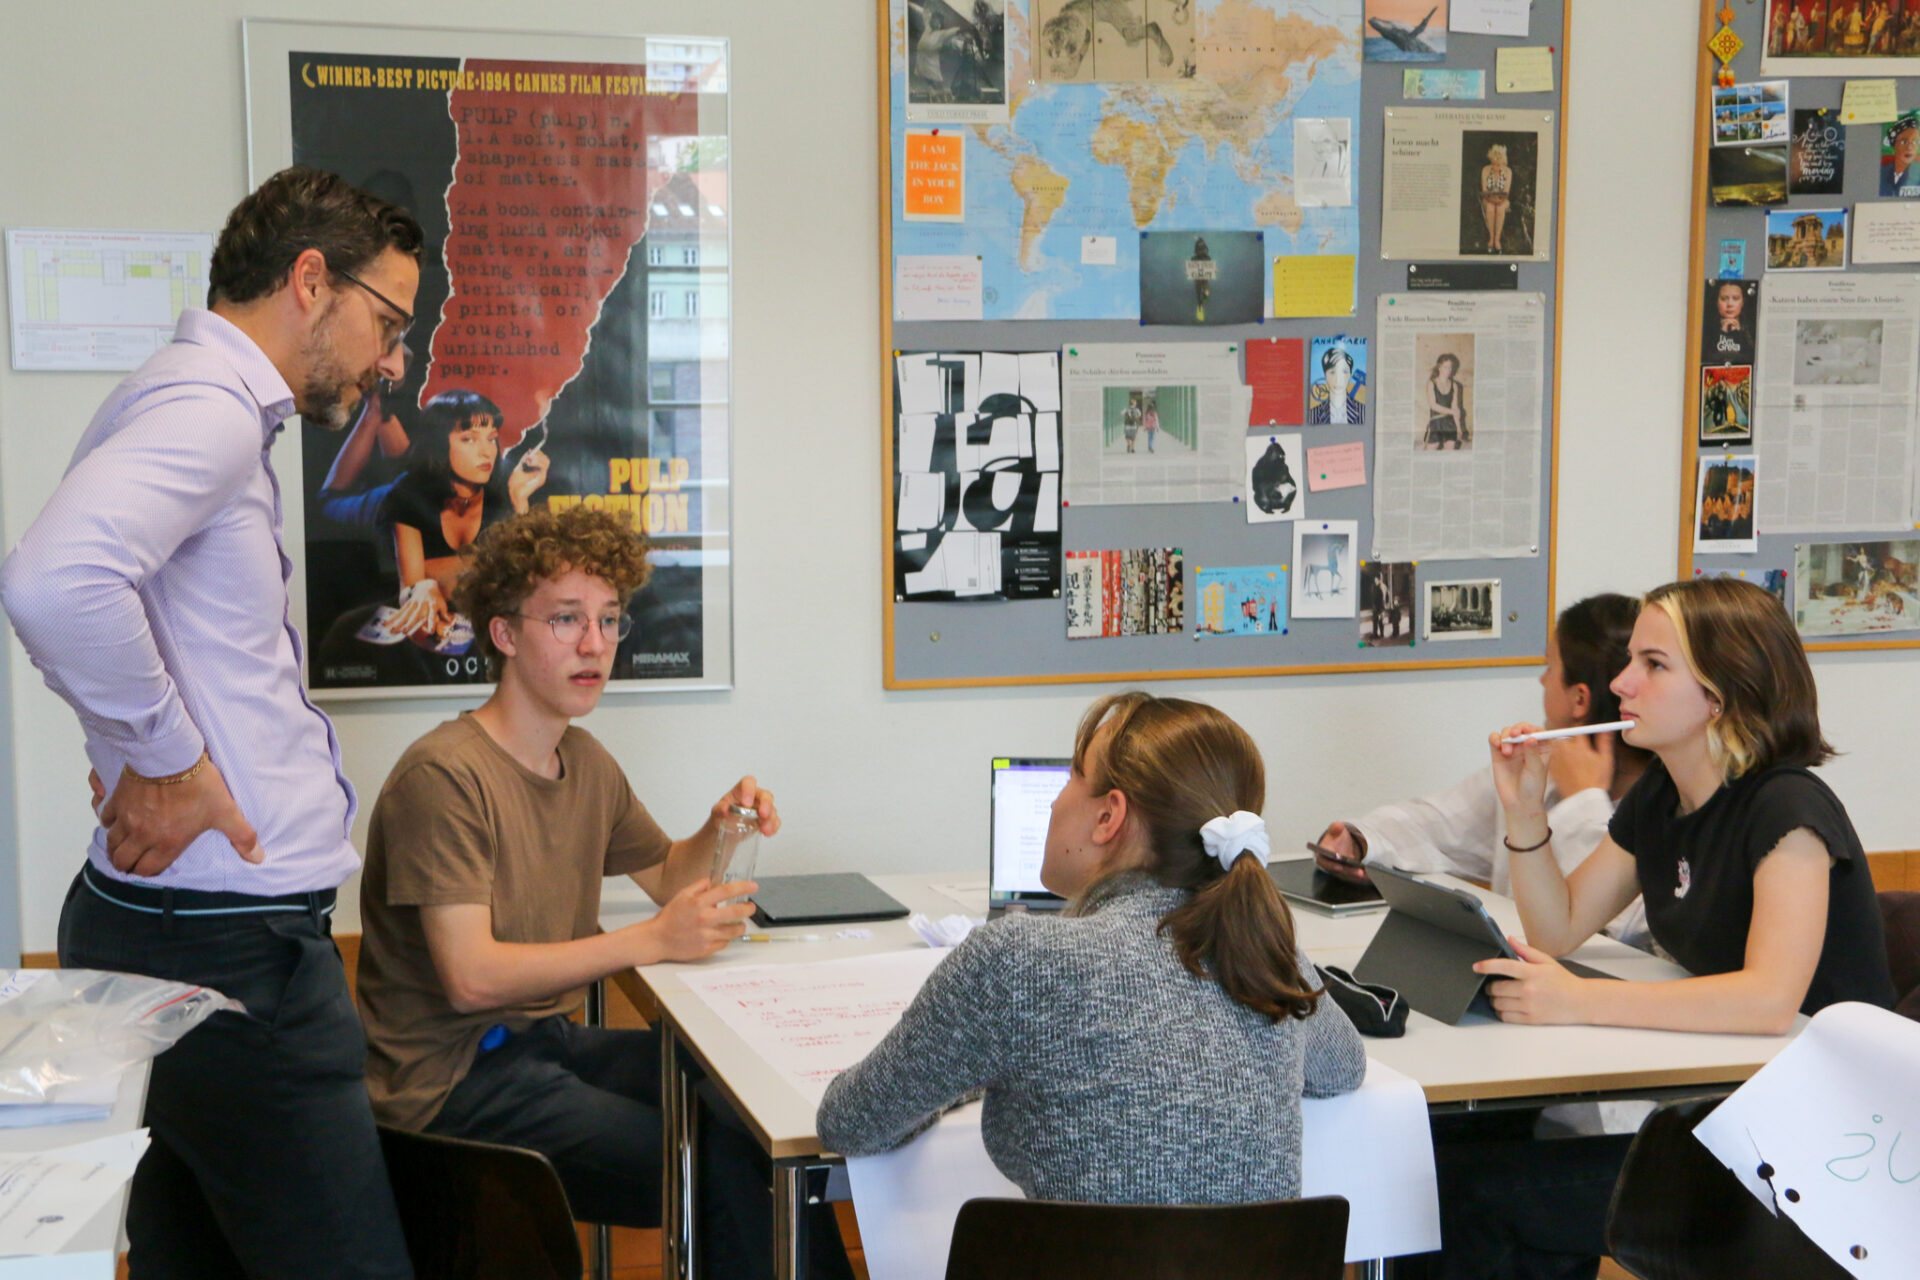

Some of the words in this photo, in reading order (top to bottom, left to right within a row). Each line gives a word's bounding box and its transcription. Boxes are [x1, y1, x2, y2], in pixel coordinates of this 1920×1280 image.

[515, 72, 566, 93] CANNES
[570, 74, 602, 95] FILM
[605, 75, 668, 97] FESTIV
[460, 107, 517, 125] PULP
[529, 109, 598, 129] (pulp)
[466, 152, 580, 168] shapeless
[463, 171, 485, 185] of
[501, 171, 578, 187] matter.
[923, 195, 945, 205] BOX
[496, 202, 540, 217] book
[458, 224, 489, 239] ing
[499, 223, 546, 238] lurid
[555, 224, 622, 241] subject
[458, 243, 550, 259] matter,
[456, 262, 513, 280] being
[461, 281, 592, 301] teristically
[459, 302, 543, 318] printed
[556, 305, 581, 317] on
[451, 323, 532, 340] rough,
[443, 341, 560, 357] unfinished
[440, 362, 509, 378] paper.
[609, 457, 689, 493] PULP
[632, 652, 690, 667] MIRAMAX
